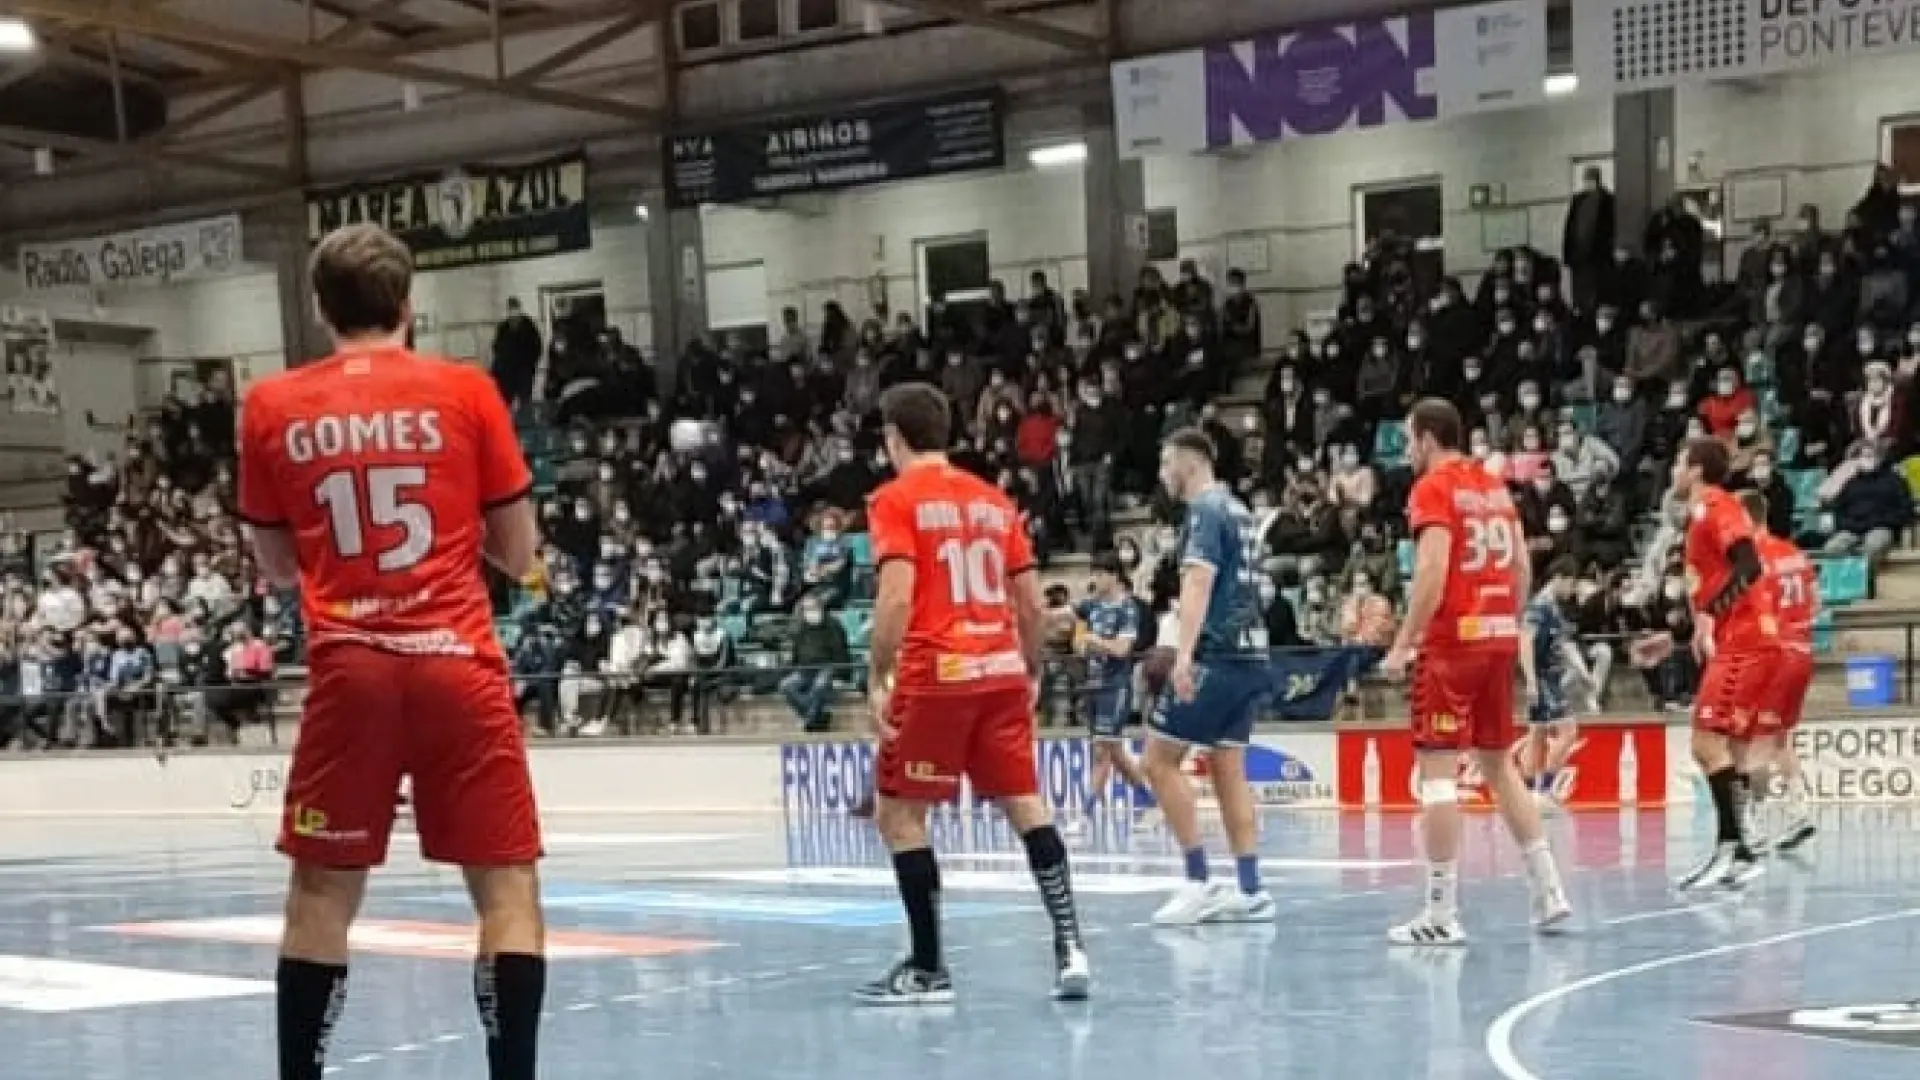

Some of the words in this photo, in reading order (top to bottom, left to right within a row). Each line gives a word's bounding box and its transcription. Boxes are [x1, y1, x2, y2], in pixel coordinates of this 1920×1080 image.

[486, 163, 575, 218] AZUL
[101, 239, 186, 283] Galega
[285, 409, 443, 462] GOMES
[313, 463, 436, 573] 15
[1459, 517, 1514, 572] 39
[936, 536, 1007, 605] 10
[1791, 726, 1920, 761] EPORT
